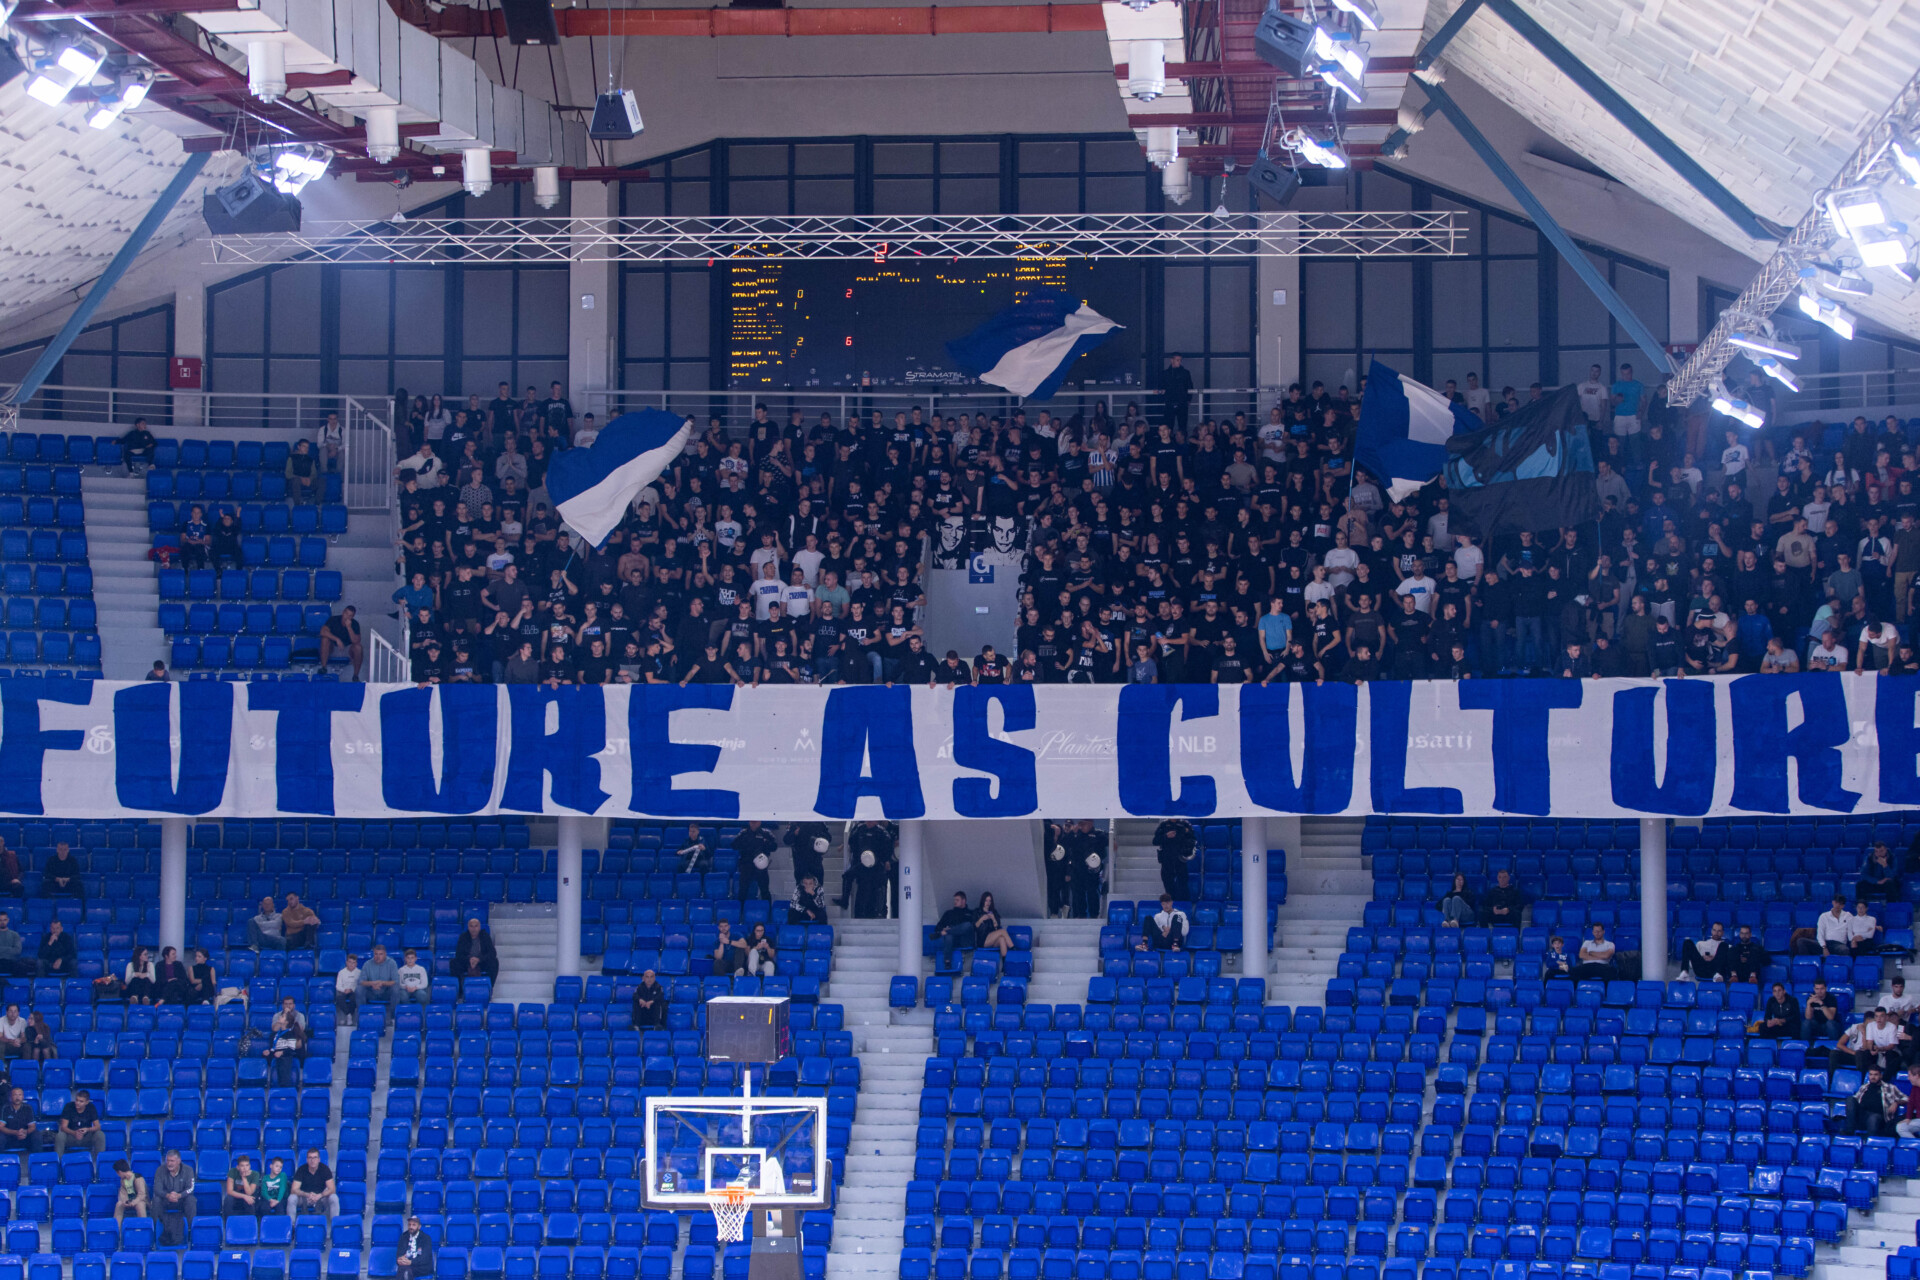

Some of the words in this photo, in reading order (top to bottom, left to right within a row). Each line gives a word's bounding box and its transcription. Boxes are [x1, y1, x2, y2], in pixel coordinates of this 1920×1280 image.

[797, 289, 803, 298] 0
[846, 288, 853, 298] 2
[797, 337, 804, 346] 2
[845, 336, 852, 346] 6
[972, 554, 991, 574] G
[0, 679, 740, 819] FUTURE
[813, 683, 1038, 819] AS
[1178, 736, 1217, 753] NLB
